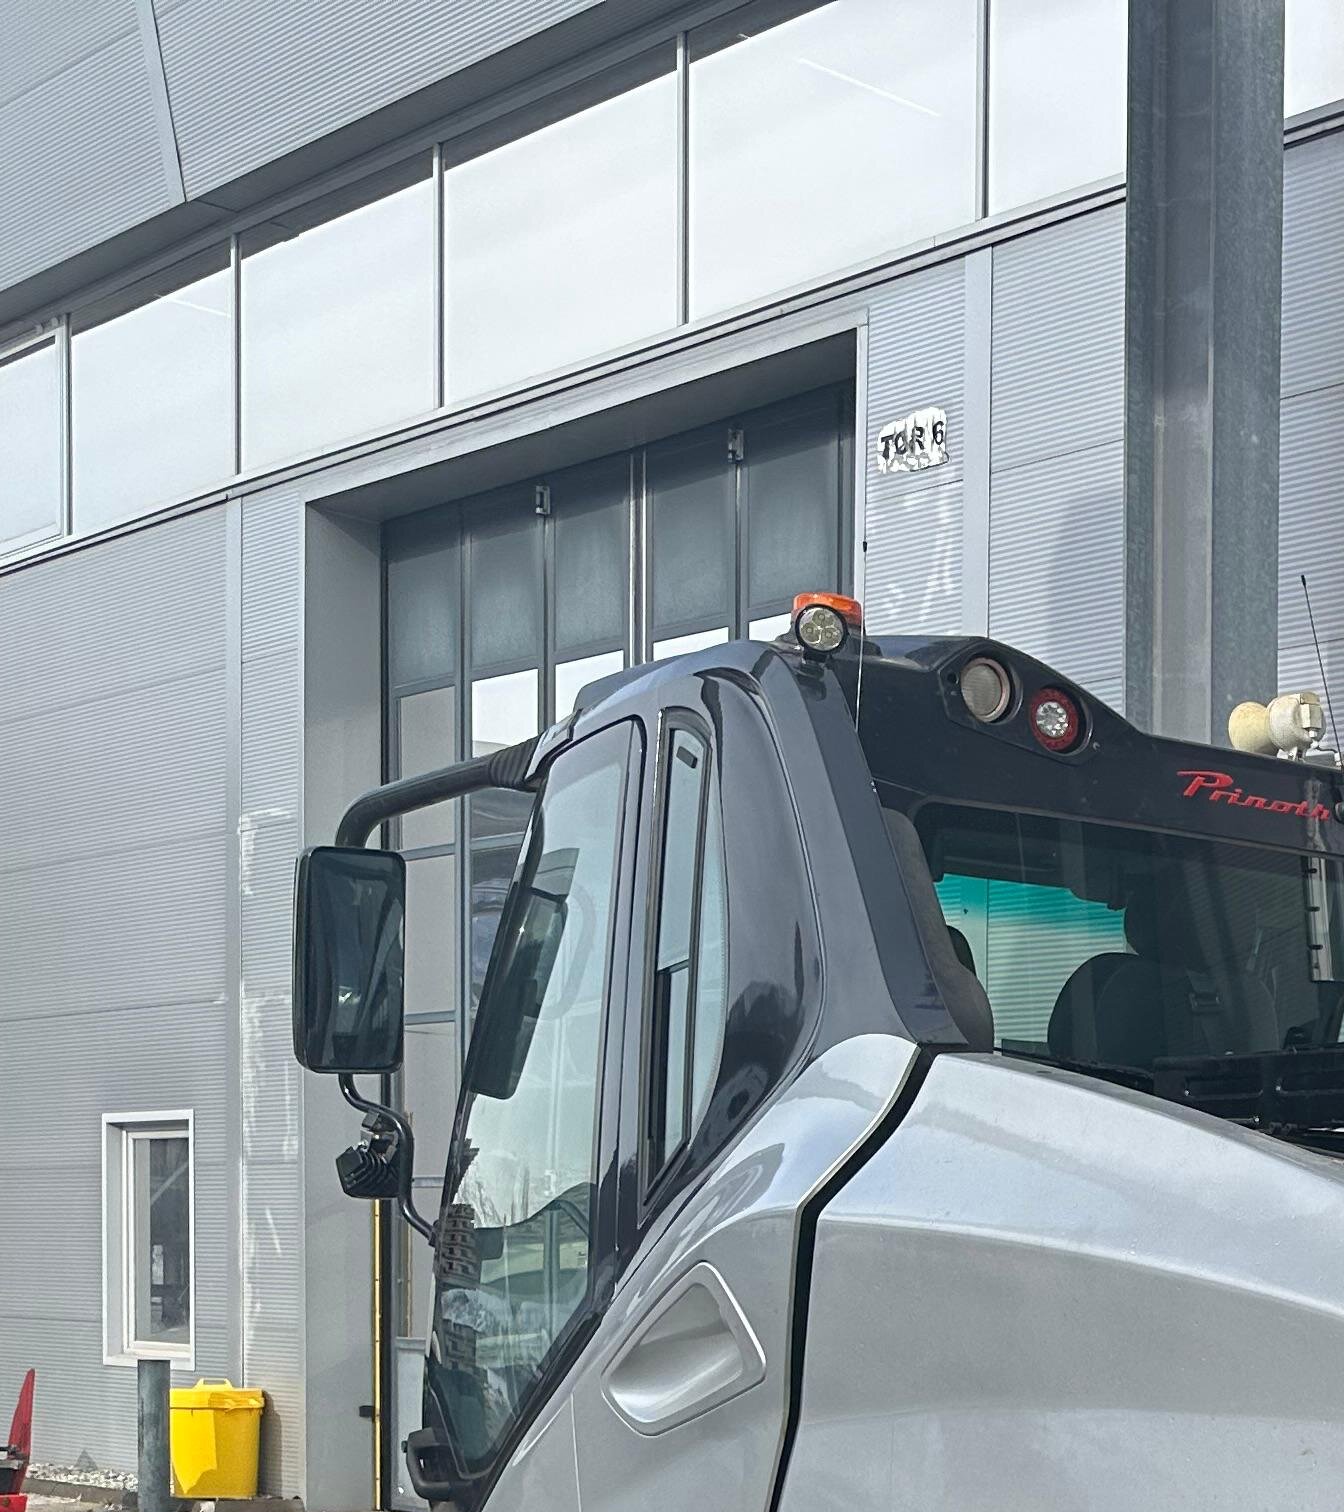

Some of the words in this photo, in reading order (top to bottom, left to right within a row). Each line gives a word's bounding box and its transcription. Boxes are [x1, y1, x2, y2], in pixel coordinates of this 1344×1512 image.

[880, 426, 925, 460] TOR
[932, 420, 945, 446] 6
[1176, 770, 1331, 822] Prinoth
